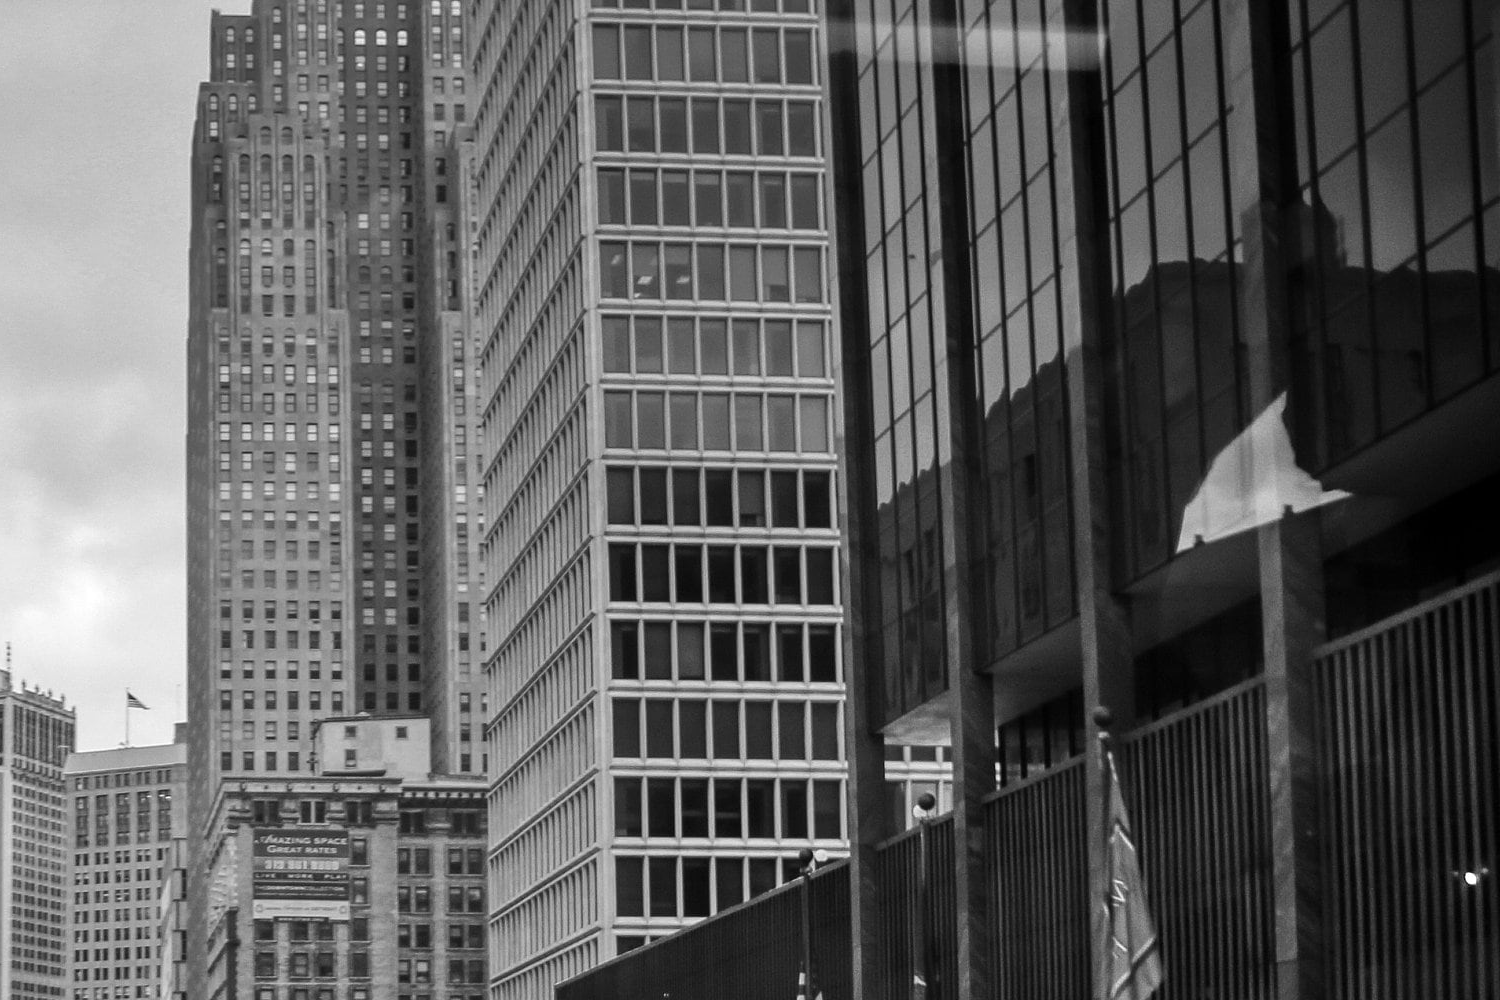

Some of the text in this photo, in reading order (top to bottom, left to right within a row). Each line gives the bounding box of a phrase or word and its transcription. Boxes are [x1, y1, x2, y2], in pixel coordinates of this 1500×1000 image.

[313, 837, 348, 845] SPACE
[266, 845, 338, 855] GREAT RATES
